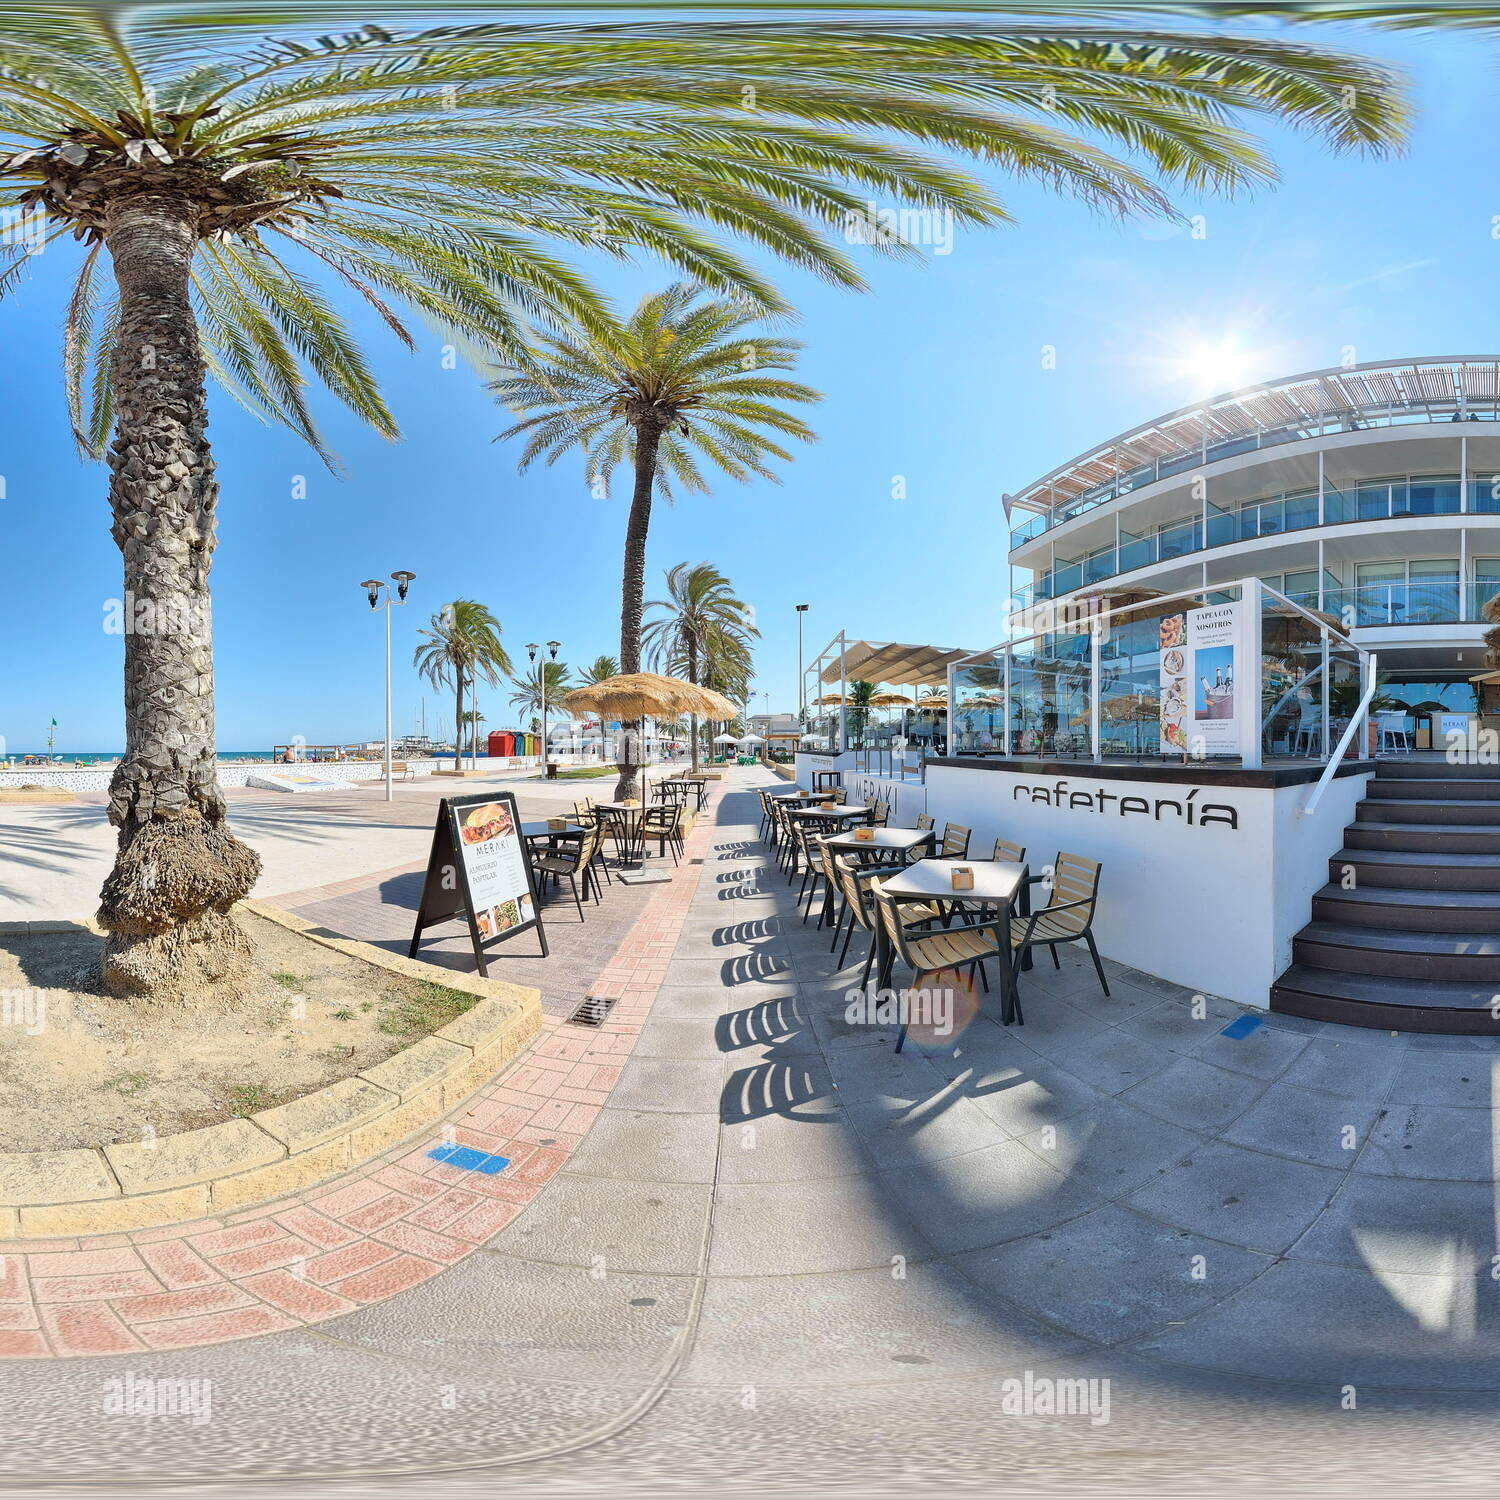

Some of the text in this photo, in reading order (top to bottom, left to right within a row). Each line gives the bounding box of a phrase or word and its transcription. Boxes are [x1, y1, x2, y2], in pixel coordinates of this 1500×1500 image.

[1196, 609, 1233, 621] TAPEA CON
[1196, 620, 1233, 631] NOSOTROS
[1013, 781, 1238, 830] cafetería
[476, 839, 510, 856] MERAKI
[469, 860, 498, 874] ALMUERZO
[472, 872, 498, 885] POPULAR
